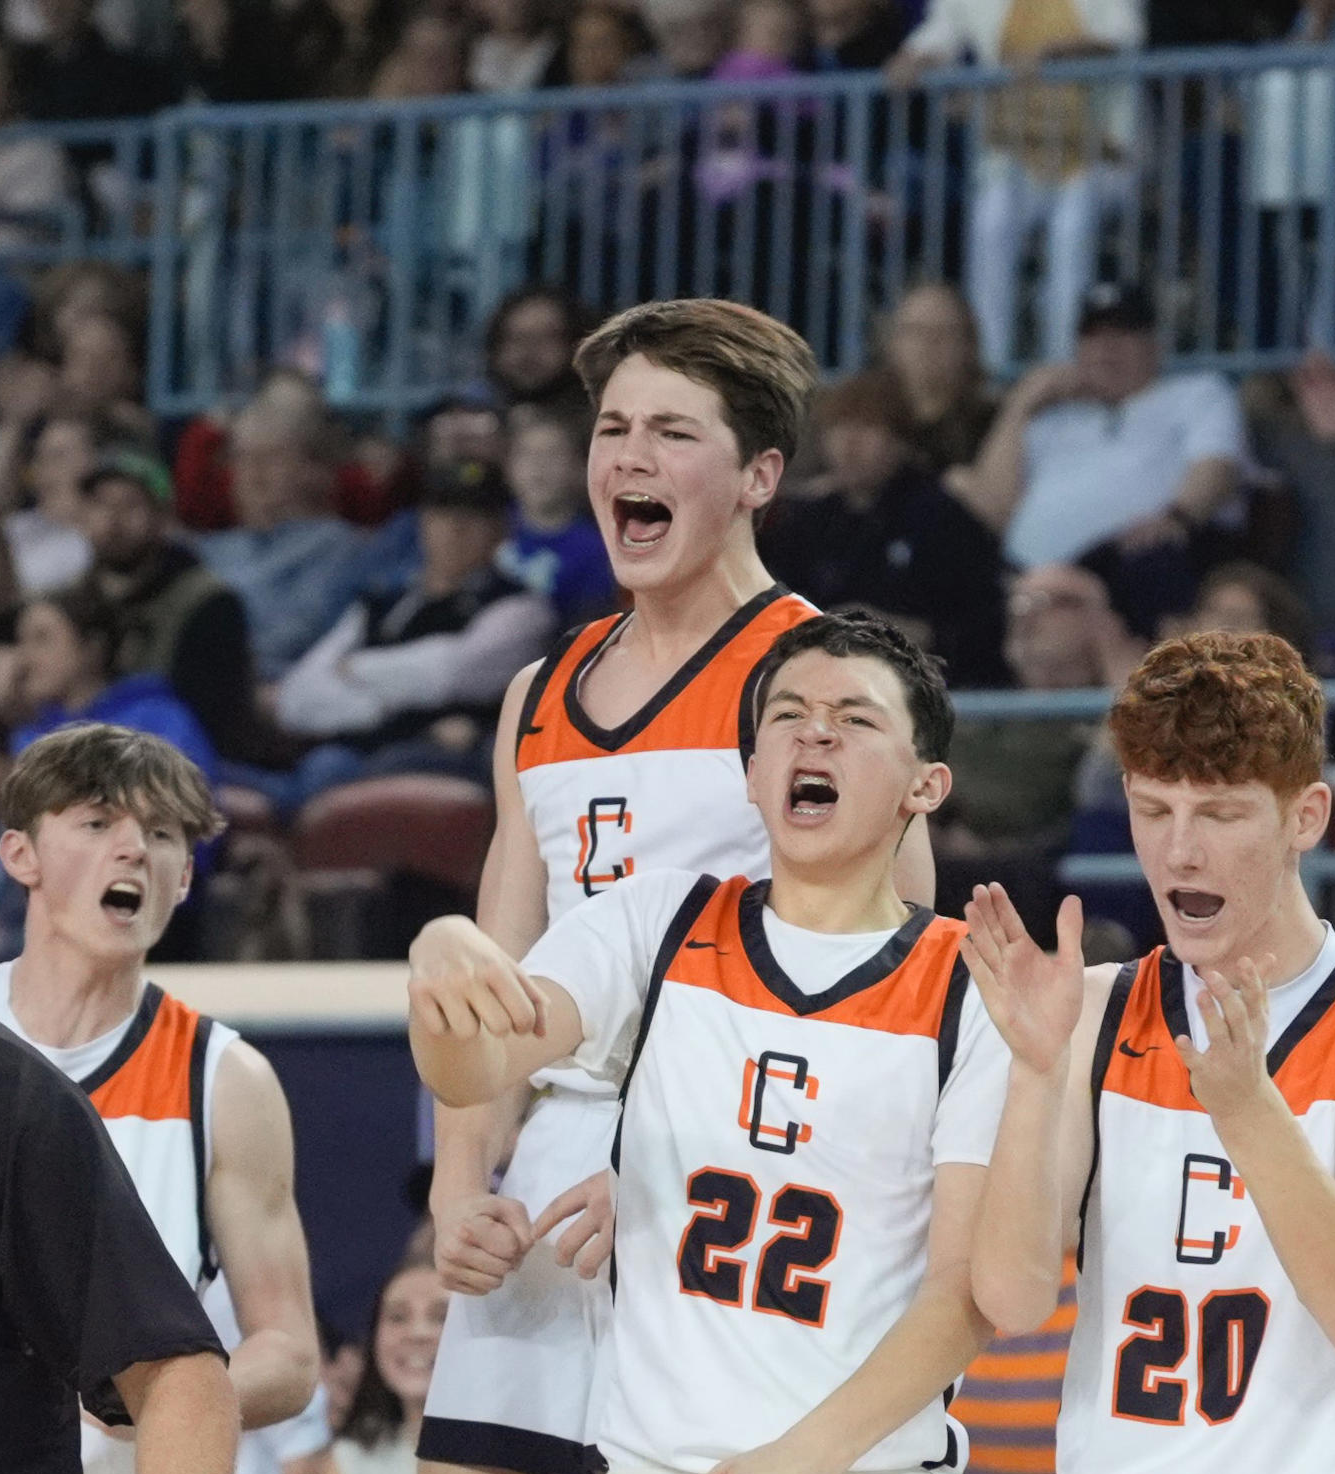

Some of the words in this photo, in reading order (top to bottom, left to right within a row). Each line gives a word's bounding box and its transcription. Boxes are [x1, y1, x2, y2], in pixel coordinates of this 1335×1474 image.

[738, 1050, 819, 1155] C
[675, 1165, 844, 1329] 22
[1174, 1152, 1245, 1265] C
[1111, 1285, 1271, 1427] 20
